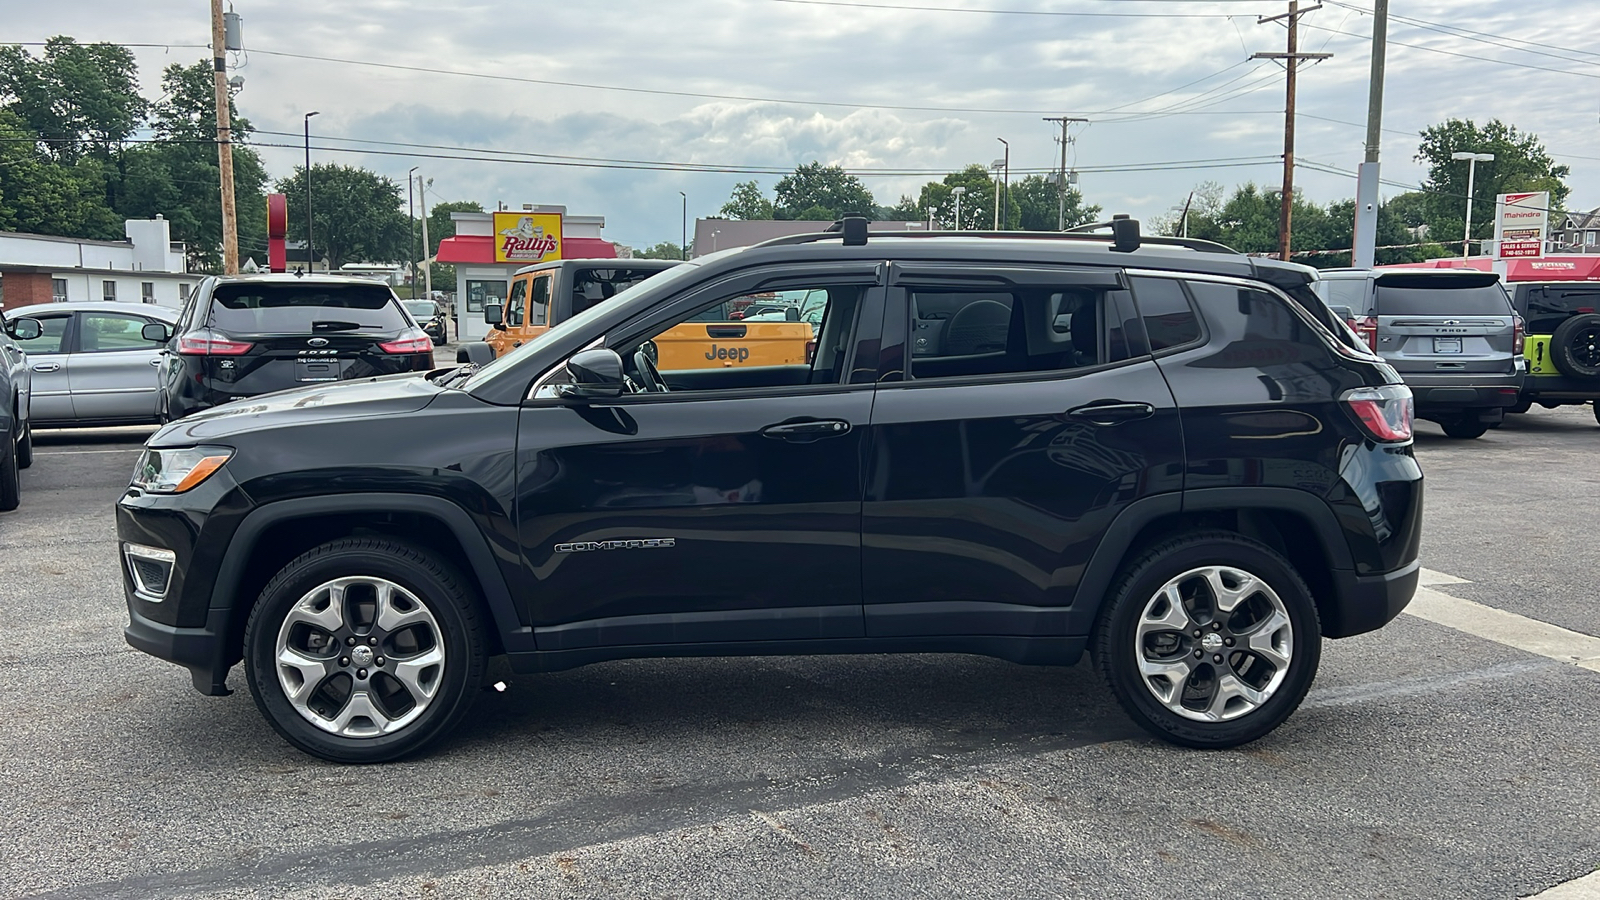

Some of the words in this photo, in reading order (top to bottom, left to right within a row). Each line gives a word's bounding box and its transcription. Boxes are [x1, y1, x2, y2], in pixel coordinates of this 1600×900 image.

[502, 234, 557, 259] Rally's
[705, 344, 749, 362] Jeep
[554, 538, 676, 552] COMPASS
